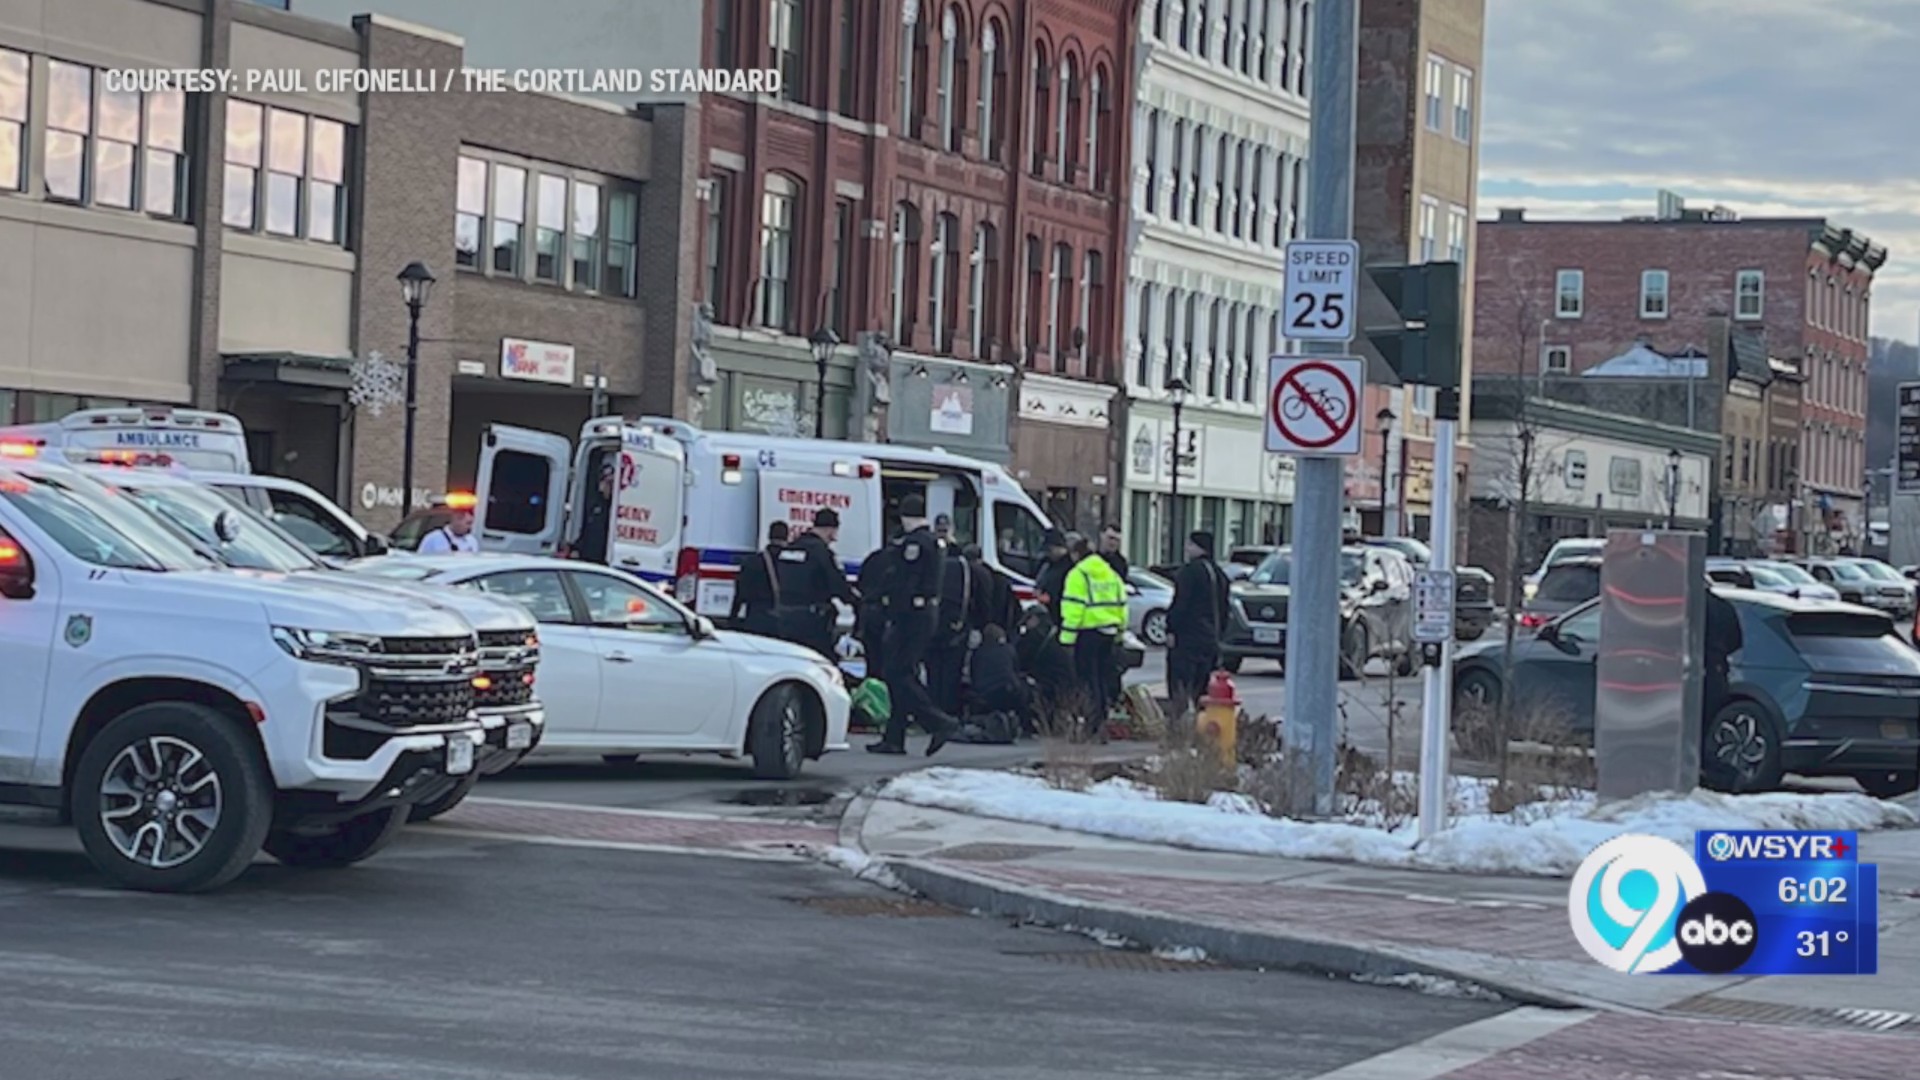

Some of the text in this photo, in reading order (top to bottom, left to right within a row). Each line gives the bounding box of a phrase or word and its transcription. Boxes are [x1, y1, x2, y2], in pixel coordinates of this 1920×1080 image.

[1291, 251, 1350, 266] SPEED
[1297, 270, 1342, 284] LIMIT
[1292, 292, 1344, 330] 25
[117, 432, 200, 448] AMBULANCE
[758, 449, 777, 468] CE
[779, 487, 850, 509] EMERGENCY
[616, 524, 658, 544] SERVICE
